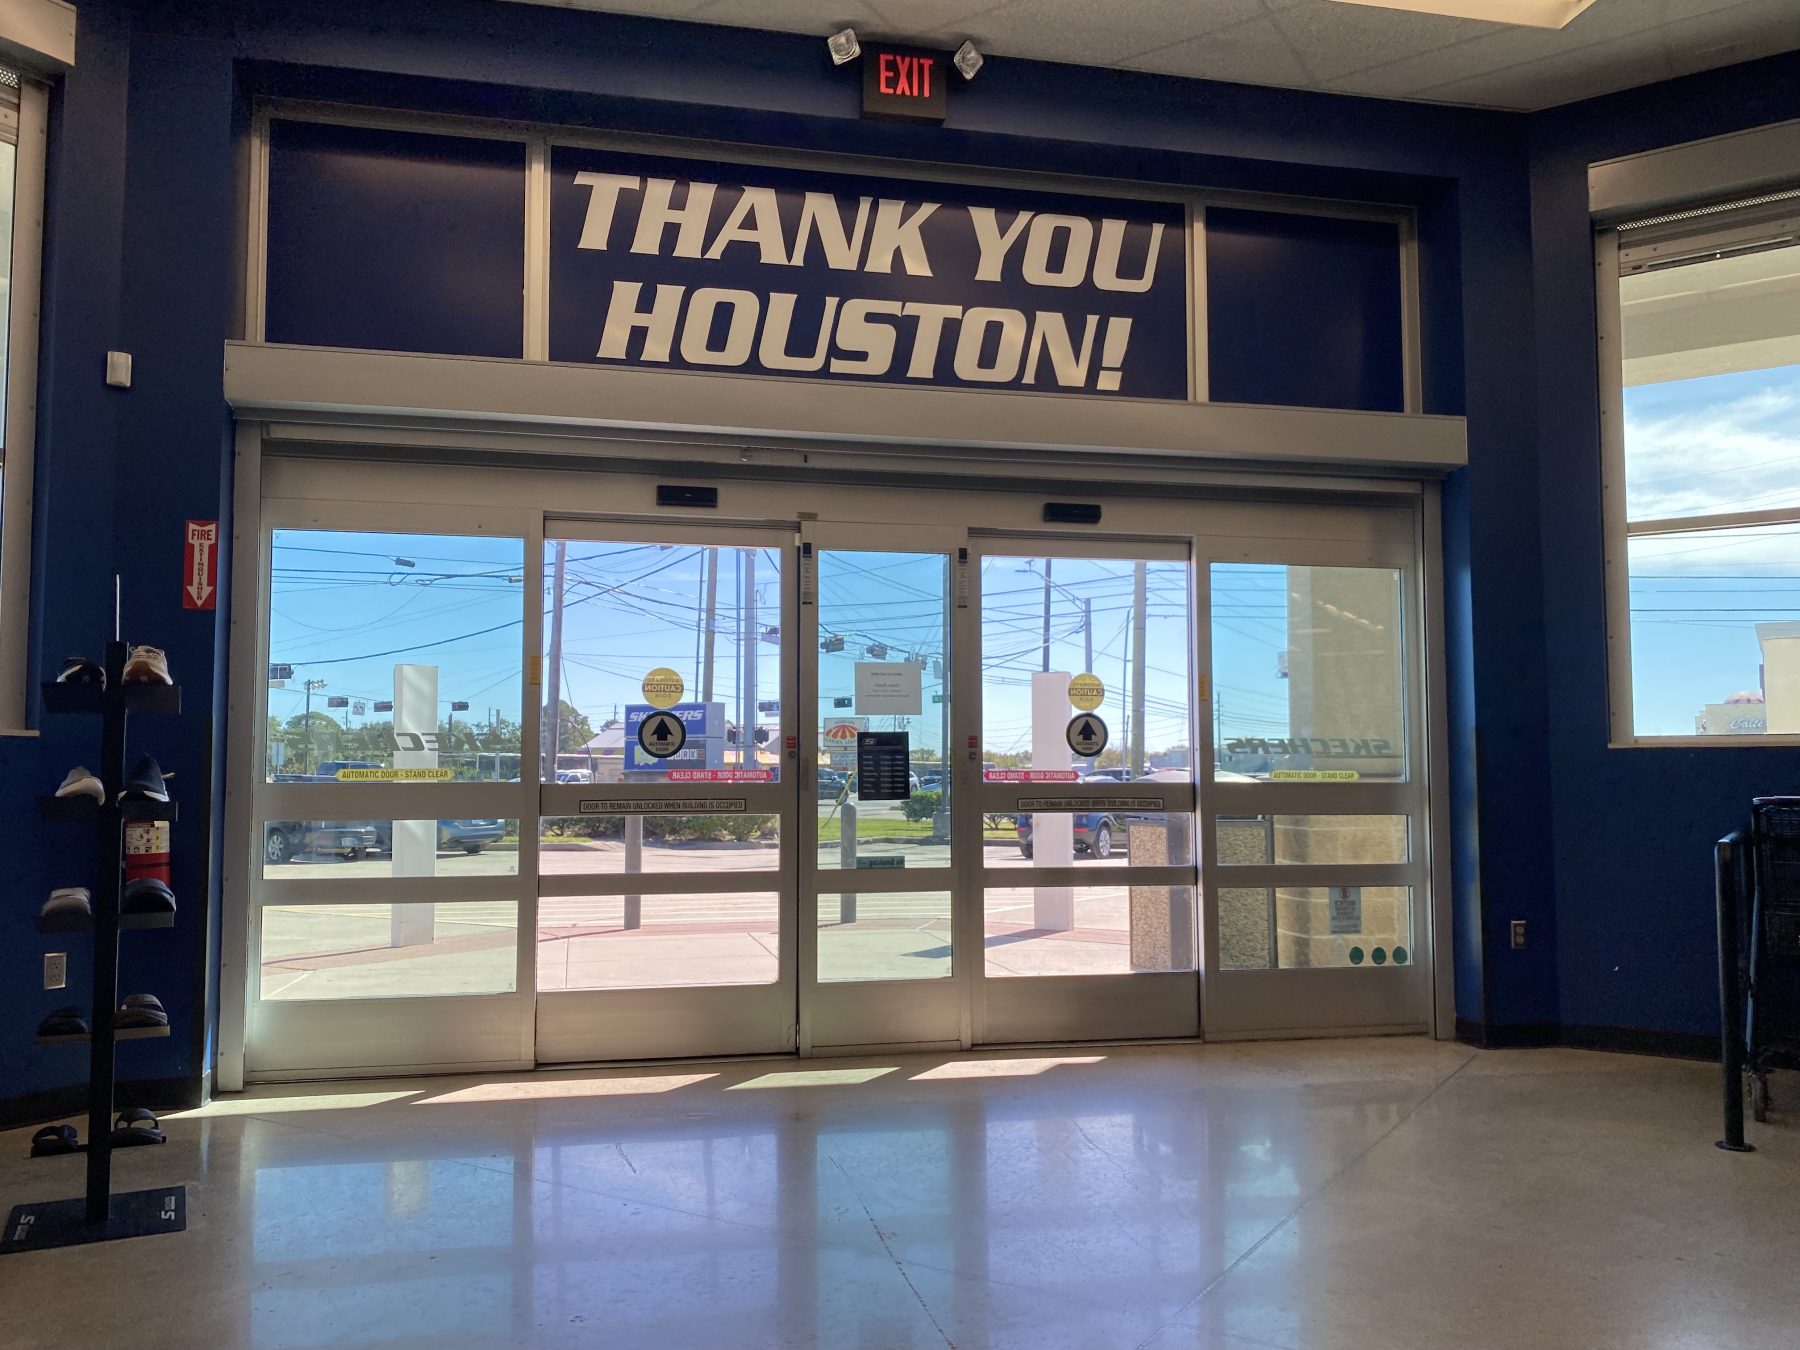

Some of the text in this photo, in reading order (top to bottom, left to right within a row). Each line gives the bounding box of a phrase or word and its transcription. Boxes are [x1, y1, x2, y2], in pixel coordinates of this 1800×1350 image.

[879, 52, 934, 99] EXIT
[573, 171, 1165, 293] THANK YOU
[597, 280, 1133, 391] HOUSTON!
[191, 529, 213, 541] FIRE
[342, 770, 380, 779] AUTOMATIC
[381, 770, 399, 779] DOOR
[405, 770, 427, 778] STAND
[427, 770, 449, 778] CLEAR
[583, 803, 600, 811] DOOR
[600, 803, 608, 811] TO
[632, 802, 663, 810] UNLOCKED
[664, 802, 681, 810] WHEN
[682, 802, 708, 810] BUILDING
